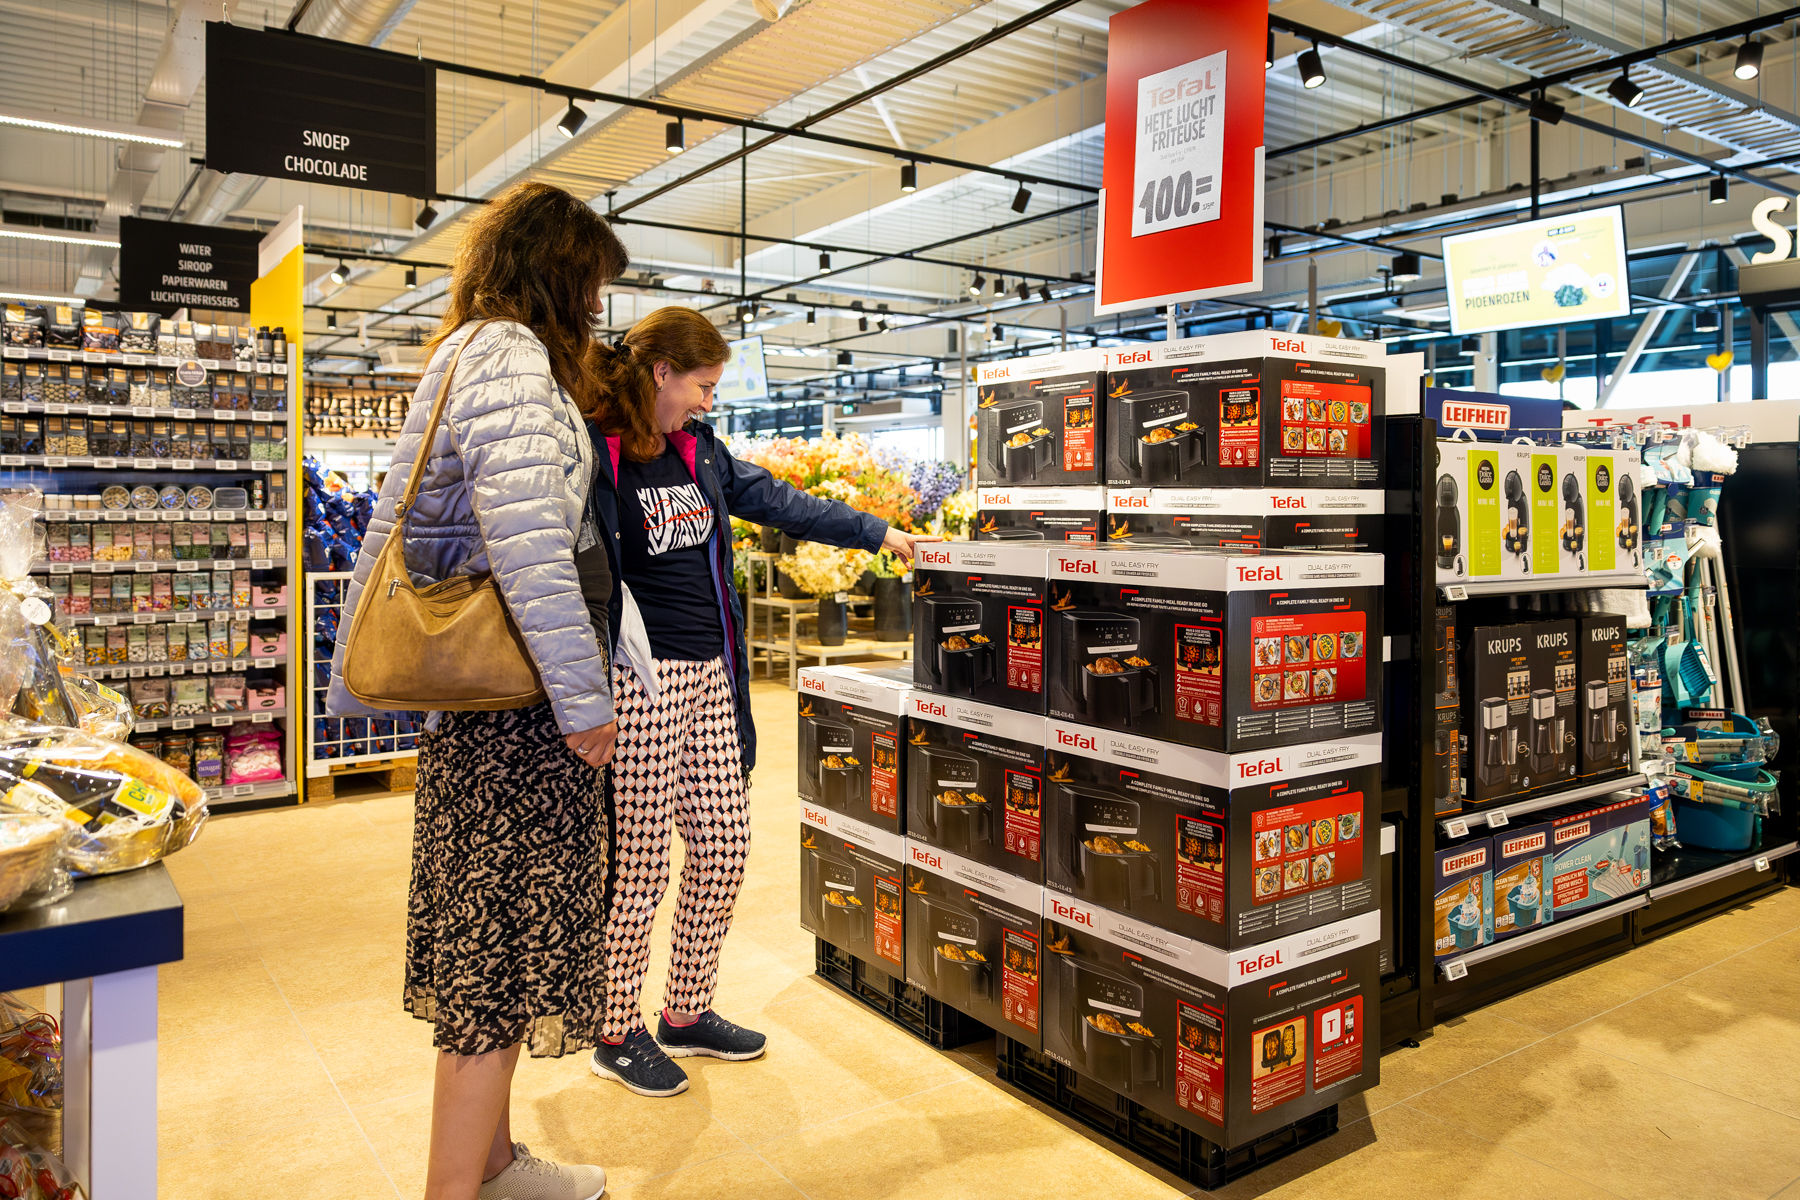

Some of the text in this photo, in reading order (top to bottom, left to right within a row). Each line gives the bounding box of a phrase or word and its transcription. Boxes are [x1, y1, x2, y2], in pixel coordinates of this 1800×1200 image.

[1146, 69, 1216, 108] Tefal
[1144, 94, 1216, 135] HETE LUCHT
[303, 130, 350, 151] SNOEP
[1152, 118, 1206, 152] FRITEUSE
[284, 155, 367, 181] CHOCOLADE
[178, 243, 212, 256] WATER
[178, 260, 213, 272] SIROOP
[162, 275, 228, 291] PAPIERWAREN
[151, 290, 240, 308] LUCHTVERFRISSERS
[1465, 290, 1530, 310] PIOENROZEN
[1270, 338, 1306, 354] Tefal
[1116, 350, 1153, 365] Tefal
[982, 366, 1011, 380] Tefal
[1446, 406, 1508, 425] LEIFHEIT
[983, 494, 1012, 504] Tefal
[1113, 496, 1149, 508] Tefal
[1270, 496, 1306, 508] Tefal
[920, 550, 952, 564] Tefal
[1058, 558, 1098, 574] Tefal
[1236, 566, 1283, 582] Tefal
[1537, 632, 1568, 648] KRUPS
[1592, 626, 1620, 642] KRUPS
[1488, 638, 1522, 654] KRUPS
[802, 676, 826, 692] Tefal
[1177, 674, 1181, 682] 2
[1177, 684, 1181, 692] 2
[915, 700, 948, 718] Tefal
[957, 707, 970, 715] DUAL
[970, 710, 983, 718] EASY
[1437, 711, 1457, 721] KRUPS
[1056, 730, 1160, 756] Tefal DUAL EASY FRY
[198, 763, 220, 773] nougat
[1237, 757, 1283, 778] Tefal
[1323, 748, 1338, 756] EASY
[804, 807, 828, 827] Tefal
[1556, 824, 1589, 841] LEIFHEIT
[1504, 835, 1544, 854] LEIFHEIT
[911, 847, 943, 870] Tefal
[961, 865, 974, 874] DUAL
[975, 868, 988, 879] EASY
[1444, 852, 1484, 872] LEIFHEIT
[1555, 854, 1592, 873] POWER CLEAN
[1508, 874, 1519, 882] TWIST
[1557, 878, 1583, 891] JEDEM WISCH
[1436, 893, 1459, 906] CLEAN TWIST
[1051, 899, 1169, 946] Tefal DUAL EASY FRY
[1237, 928, 1350, 976] Tefal DUAL EASY FRY
[1327, 1018, 1336, 1032] T
[1178, 1050, 1183, 1059] 2
[1178, 1062, 1183, 1071] 2
